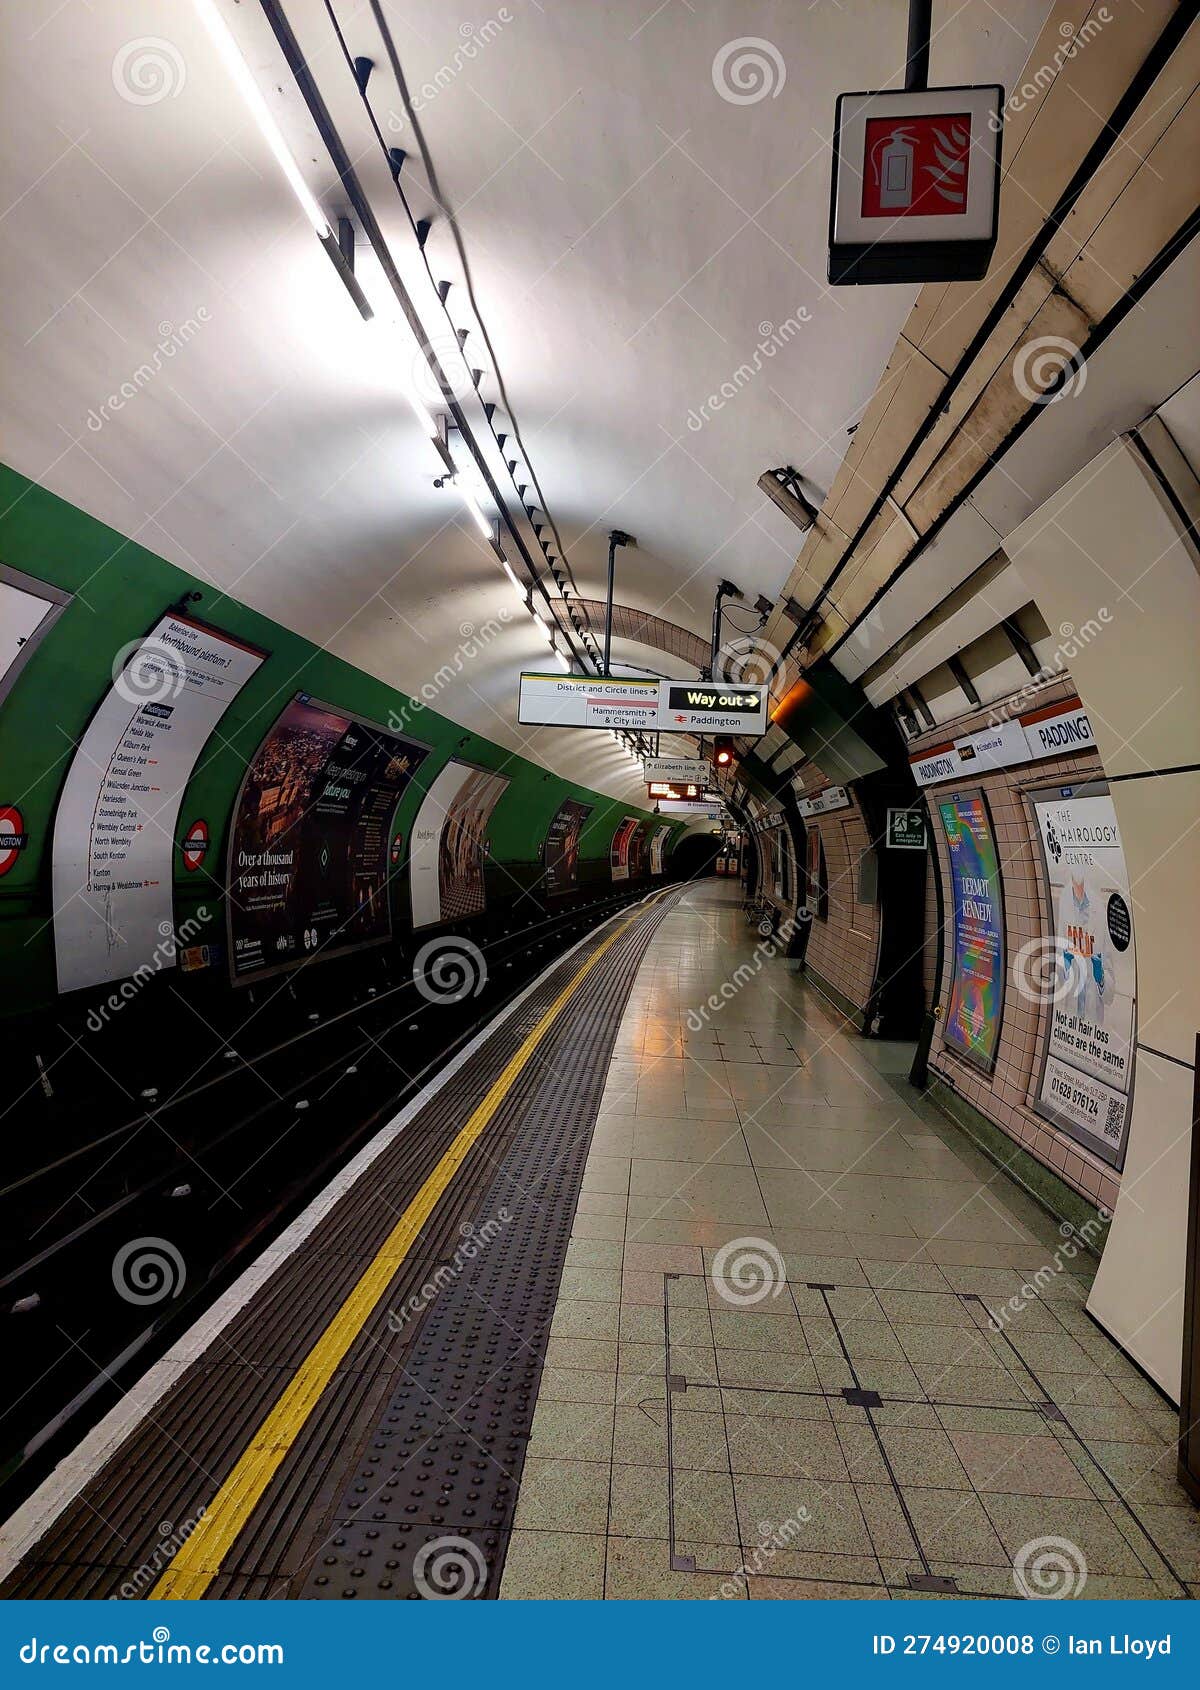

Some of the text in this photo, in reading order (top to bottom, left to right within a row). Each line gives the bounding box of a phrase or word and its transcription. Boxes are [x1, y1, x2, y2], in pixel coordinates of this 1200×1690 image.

[159, 632, 201, 657] Northbound
[199, 649, 226, 666] platform
[224, 659, 233, 669] 3
[557, 683, 585, 692] District
[605, 686, 627, 694] Circle
[630, 687, 648, 695] lines
[687, 692, 743, 708] Way out
[592, 707, 647, 717] Hammersmith
[136, 716, 172, 731] Warwick Avenue
[605, 716, 646, 726] & City line
[690, 715, 741, 727] Paddington
[130, 728, 154, 739] Maida Vale
[123, 740, 151, 752] Kilburn Park
[116, 753, 136, 763] Queen's
[136, 756, 148, 765] Park
[111, 767, 142, 778] Kensal Green
[653, 762, 696, 771] Elizabeth line
[918, 758, 955, 781] PADDINGTON
[106, 780, 151, 792] Willesden Junction
[102, 794, 127, 803] Harlesden
[98, 808, 138, 819] Stonebridge Park
[1056, 810, 1071, 822] THE
[96, 823, 137, 832] Wembley Central
[1060, 826, 1117, 842] HAIROLOGY
[94, 837, 132, 848] North Wembley
[93, 851, 126, 860] South Kenton
[238, 849, 294, 867] Over a thousand
[1065, 853, 1094, 866] CENTRE
[93, 869, 111, 877] Kenton
[93, 883, 111, 892] Harrow
[117, 880, 143, 889] Wealdstone
[238, 870, 290, 892] years of history
[961, 876, 990, 898] DERMOT
[962, 899, 992, 923] KENNEDY
[1055, 1009, 1109, 1045] Not all hair loss
[1053, 1026, 1075, 1046] clinics
[1075, 1037, 1087, 1052] are
[1089, 1041, 1101, 1059] the
[1102, 1050, 1125, 1070] same
[1051, 1077, 1098, 1116] 01628 876124
